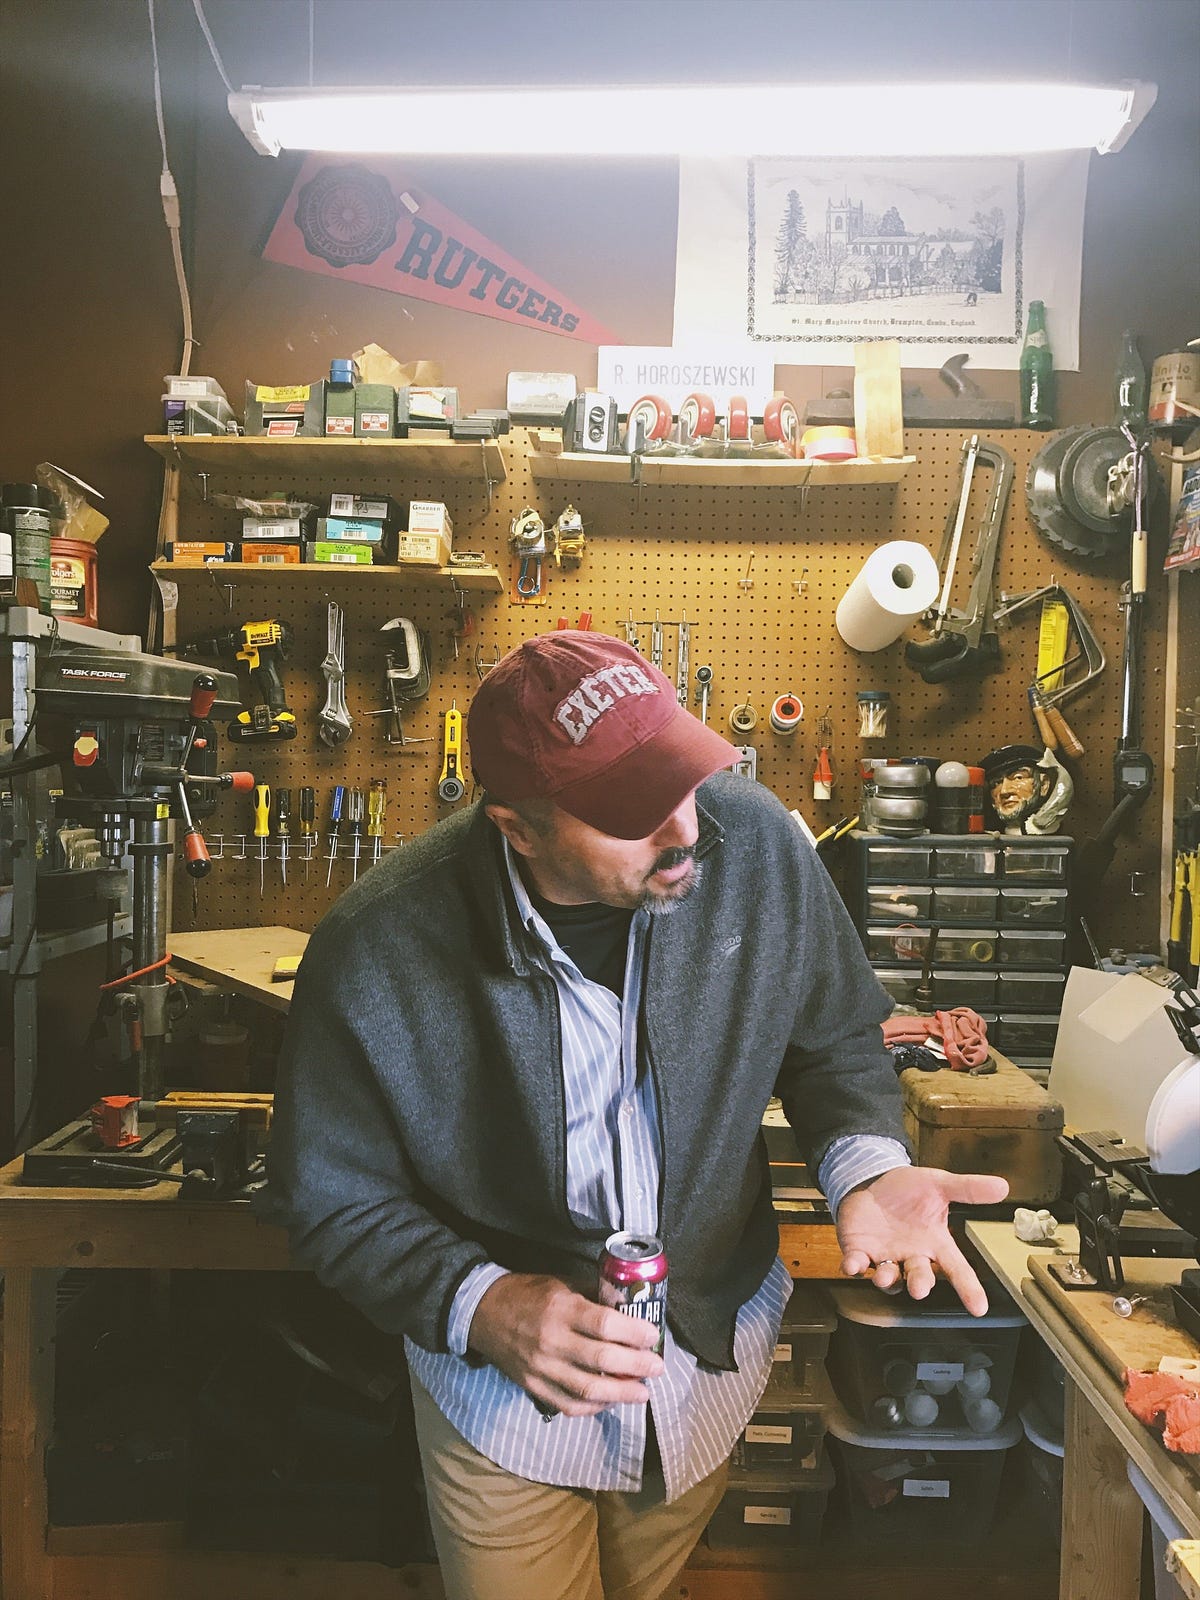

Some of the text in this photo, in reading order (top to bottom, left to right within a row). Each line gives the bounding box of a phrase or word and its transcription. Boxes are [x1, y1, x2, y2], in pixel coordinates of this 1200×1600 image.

[394, 217, 580, 333] RUTGERS
[805, 318, 822, 326] Mary
[614, 364, 755, 387] R. HOROSZEWSKI
[51, 568, 75, 579] olgers
[50, 588, 80, 597] OURMET
[61, 668, 127, 679] TASK FORCE
[557, 664, 660, 744] EXETER
